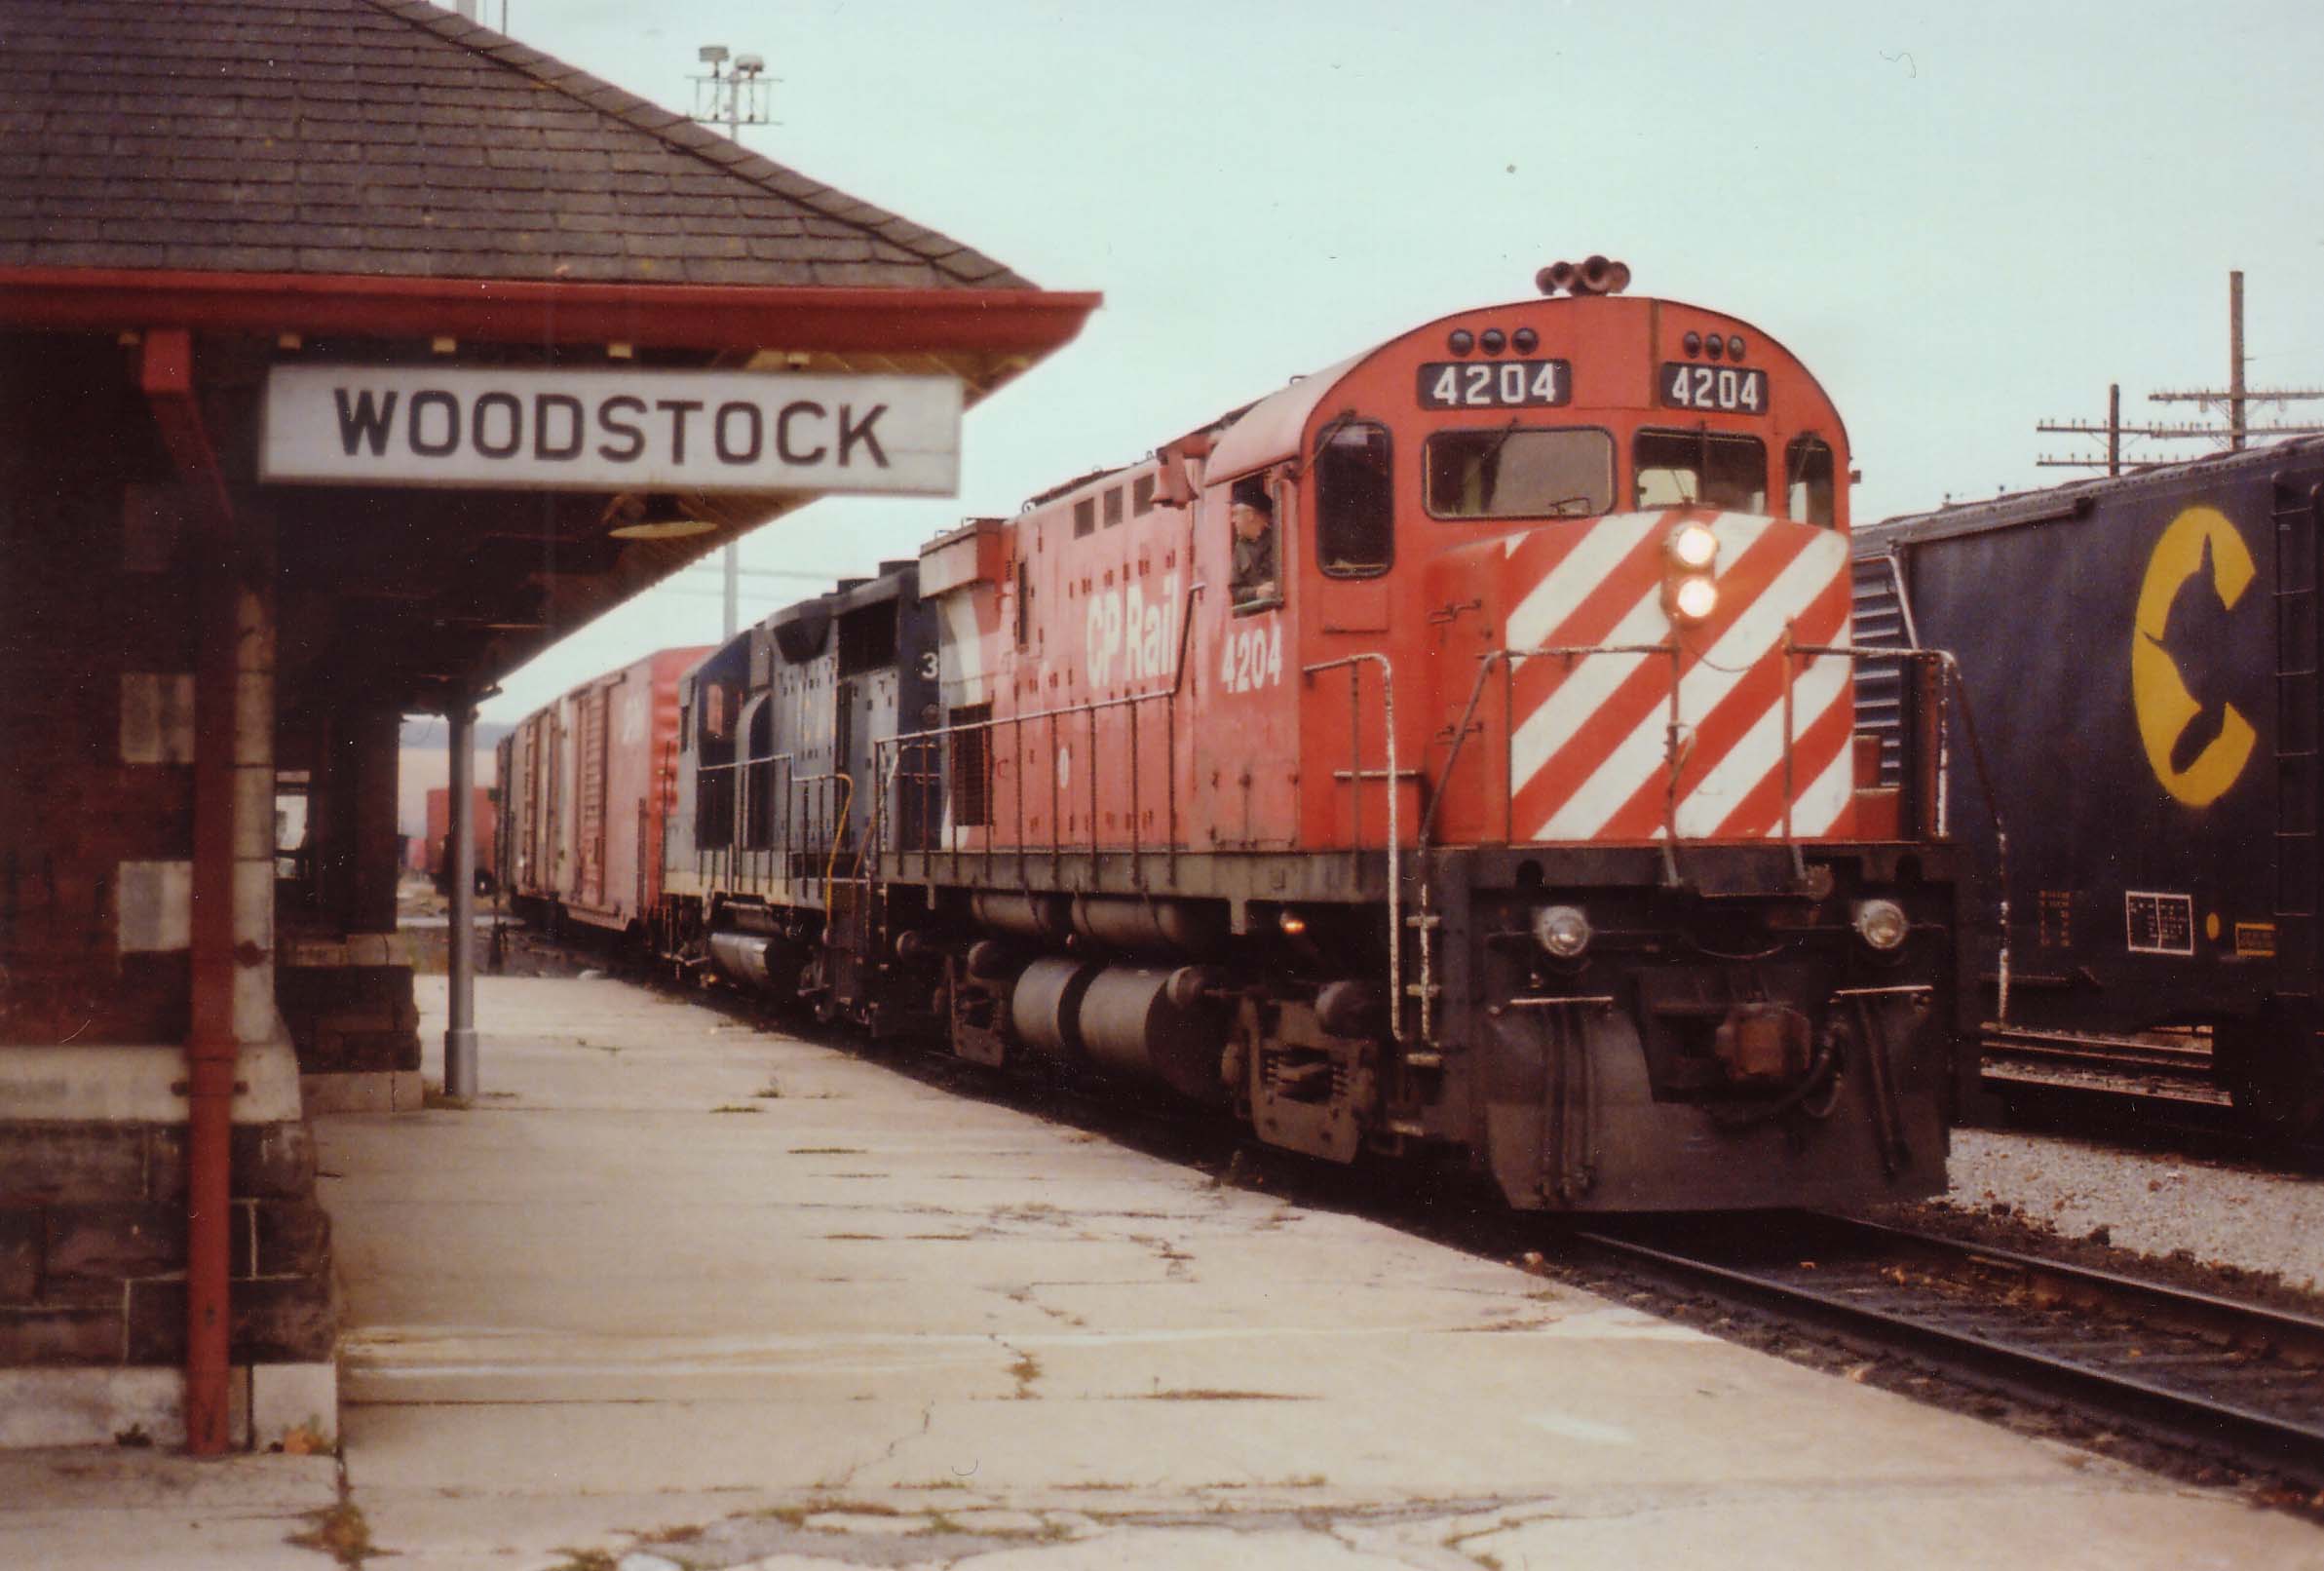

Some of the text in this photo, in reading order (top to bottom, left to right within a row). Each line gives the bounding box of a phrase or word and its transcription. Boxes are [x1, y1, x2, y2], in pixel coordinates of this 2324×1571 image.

[1432, 363, 1557, 405] 4204
[1671, 365, 1759, 410] 4204
[333, 386, 891, 469] WOODSTOCK
[1086, 571, 1178, 689] CP Rail
[1221, 620, 1282, 694] 4204
